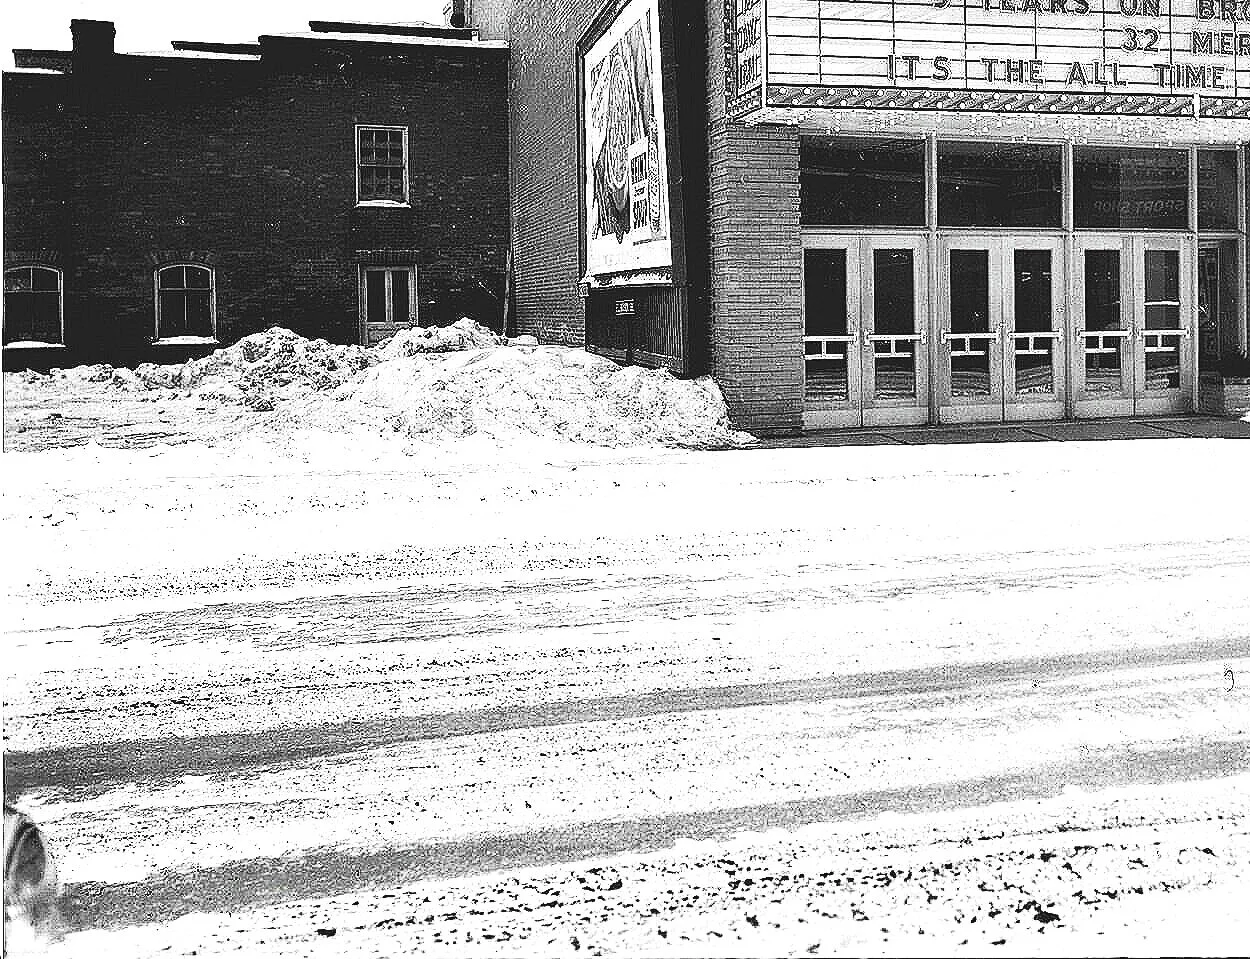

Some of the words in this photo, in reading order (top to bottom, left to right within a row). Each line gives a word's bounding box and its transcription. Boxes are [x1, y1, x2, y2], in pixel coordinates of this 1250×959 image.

[1122, 27, 1159, 52] 32
[981, 57, 1043, 84] THE
[1066, 61, 1127, 87] ALL
[1153, 63, 1226, 90] TIME
